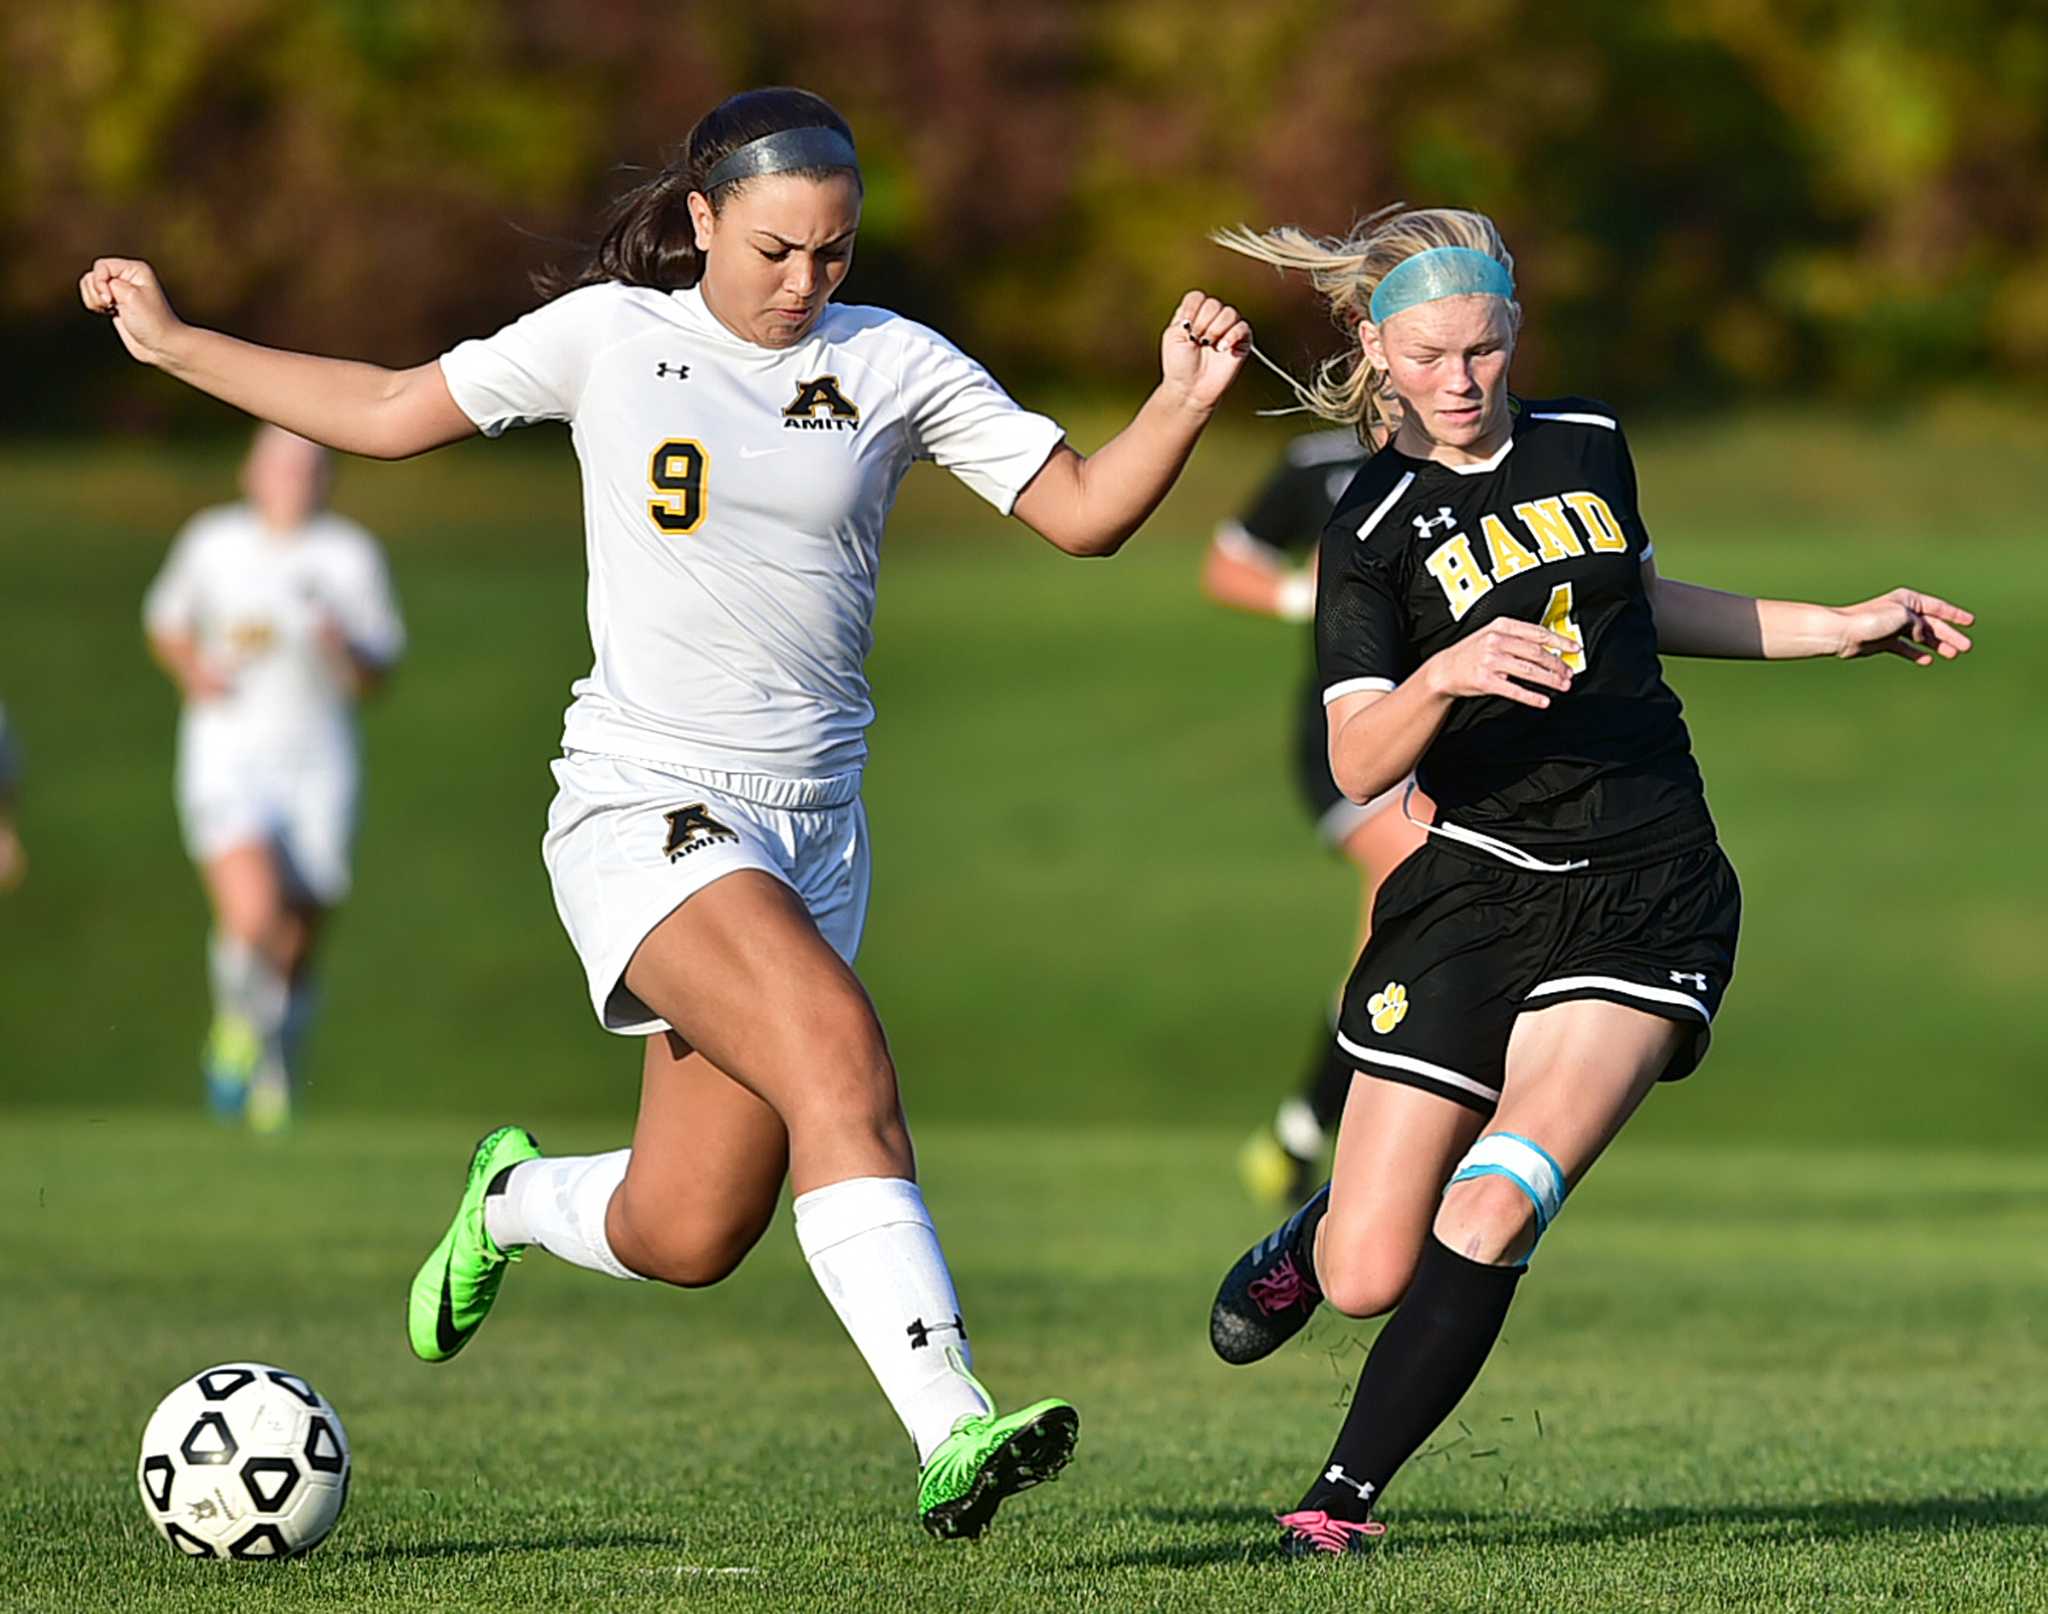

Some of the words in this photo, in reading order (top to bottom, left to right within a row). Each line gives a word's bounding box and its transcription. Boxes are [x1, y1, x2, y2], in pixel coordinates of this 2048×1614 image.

[782, 374, 859, 419] A
[784, 417, 860, 431] AMITY
[647, 438, 710, 535] 9
[1424, 491, 1628, 622] HAND
[662, 803, 739, 857] A
